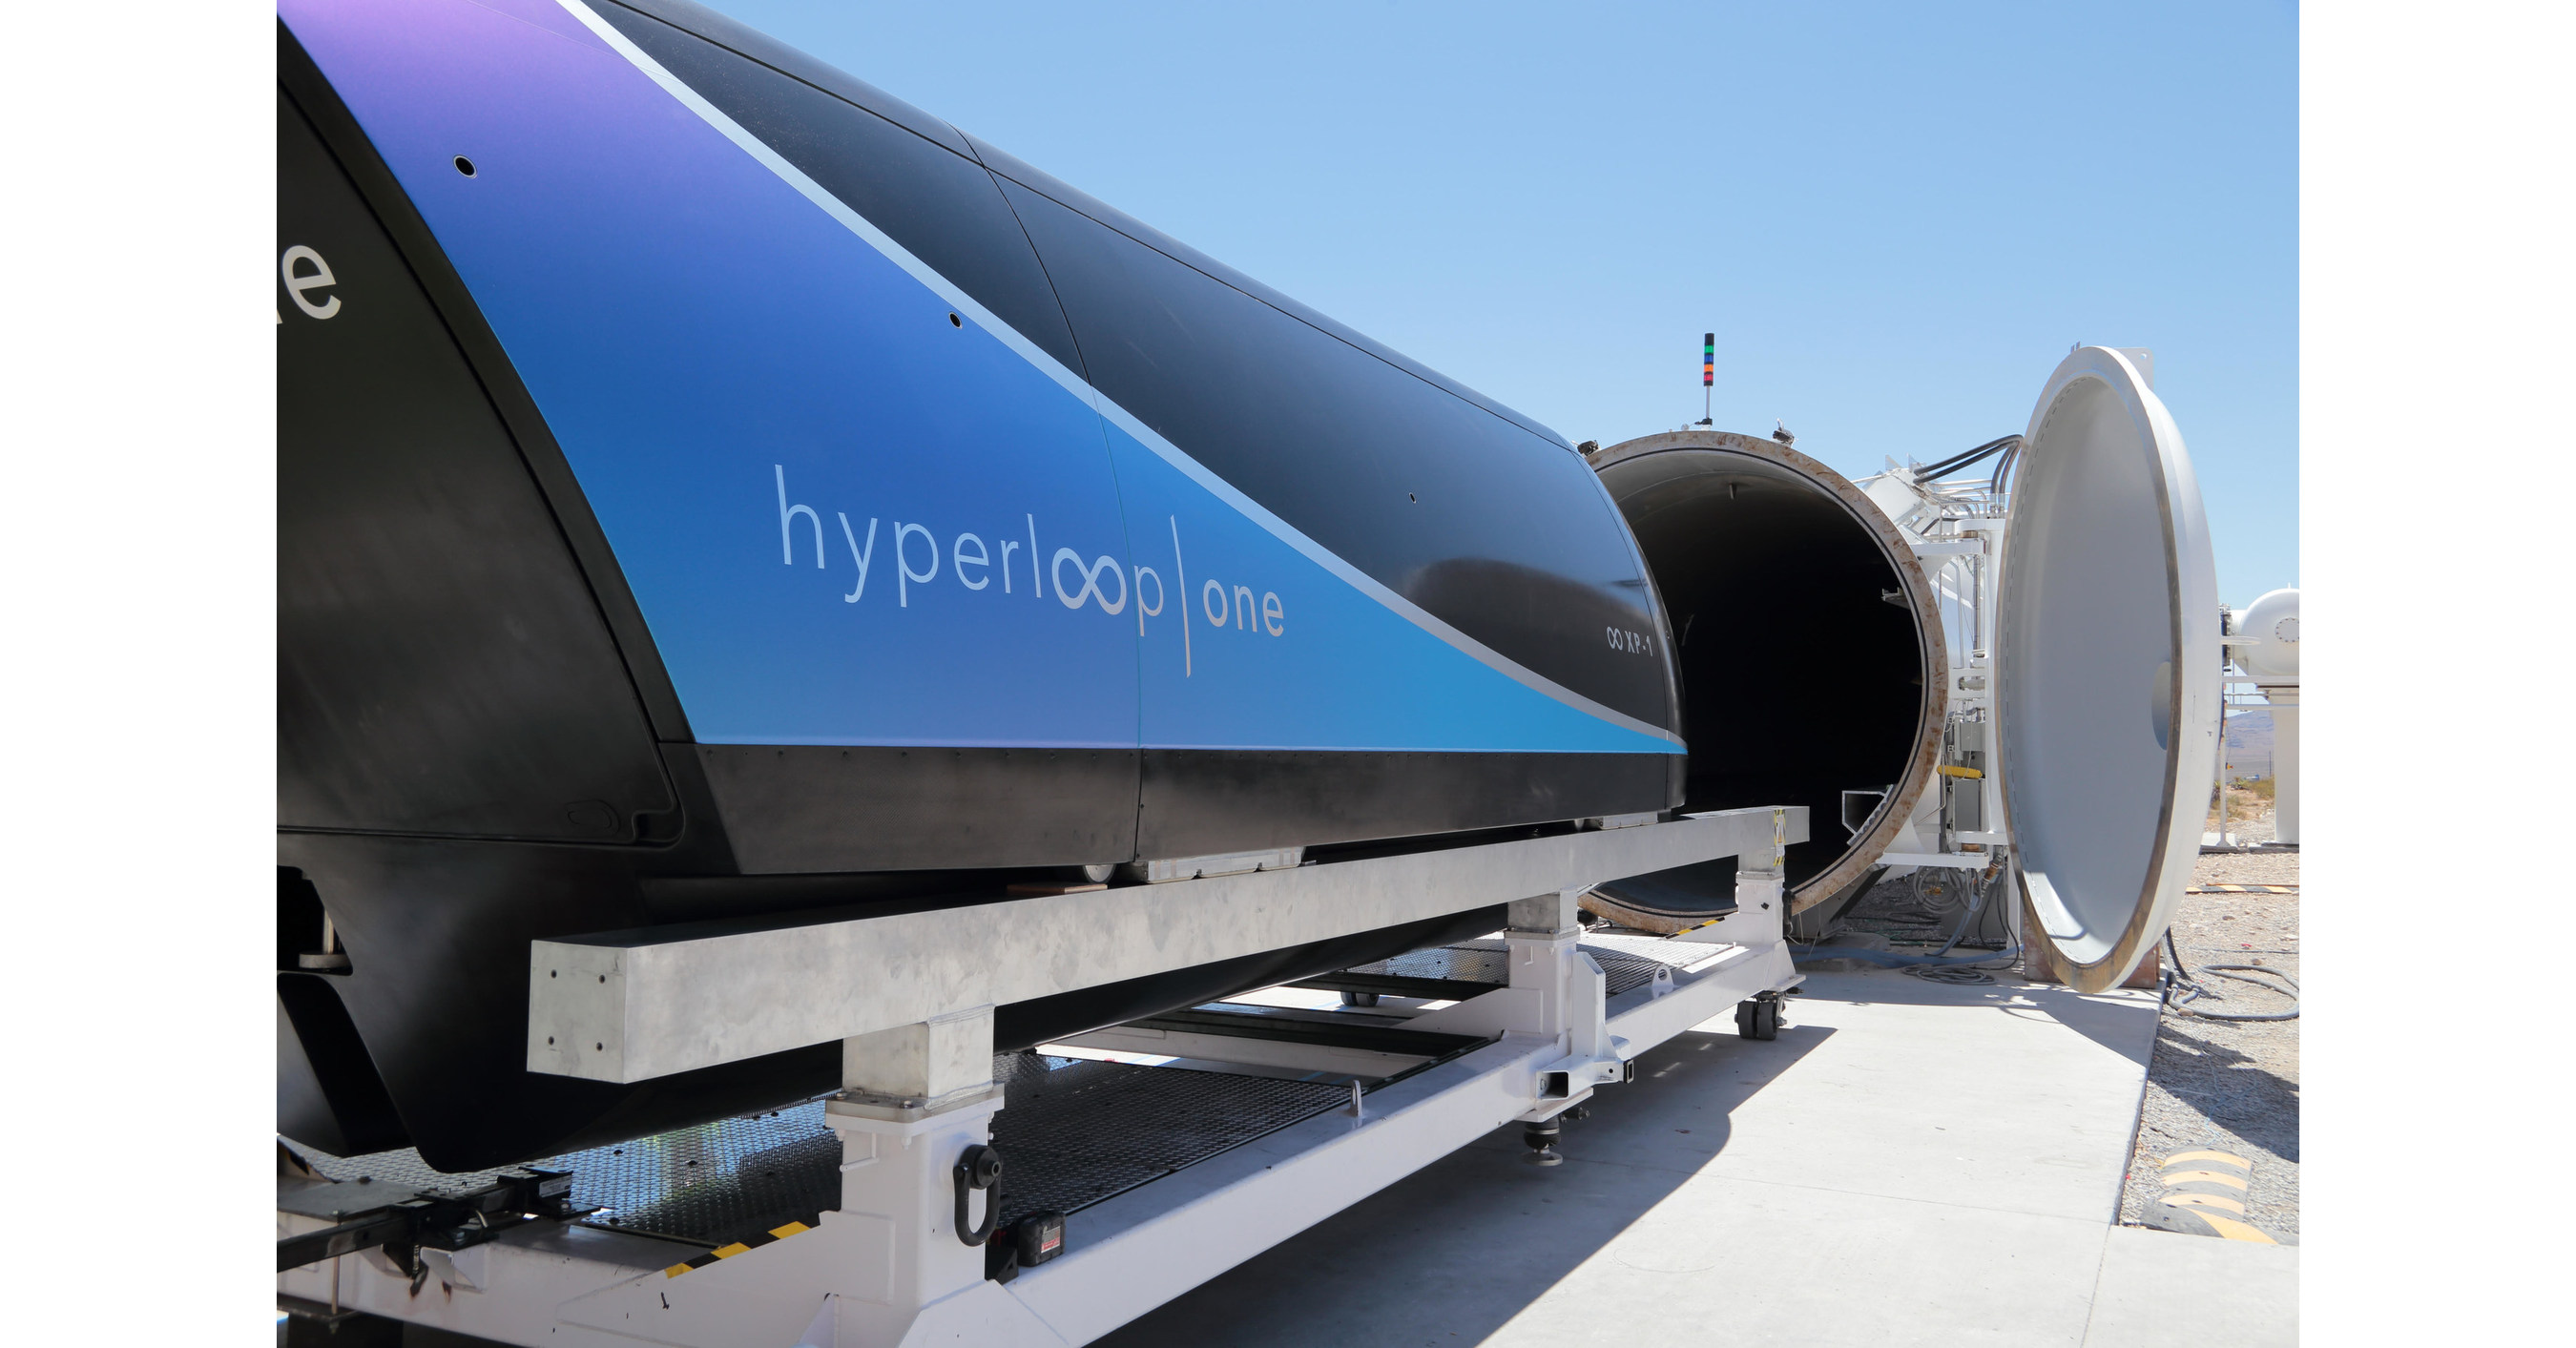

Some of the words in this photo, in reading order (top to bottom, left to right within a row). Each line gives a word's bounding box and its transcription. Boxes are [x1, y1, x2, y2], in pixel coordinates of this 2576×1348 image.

[277, 244, 342, 324] e
[774, 464, 1165, 637] hyperloop
[1201, 578, 1285, 637] one
